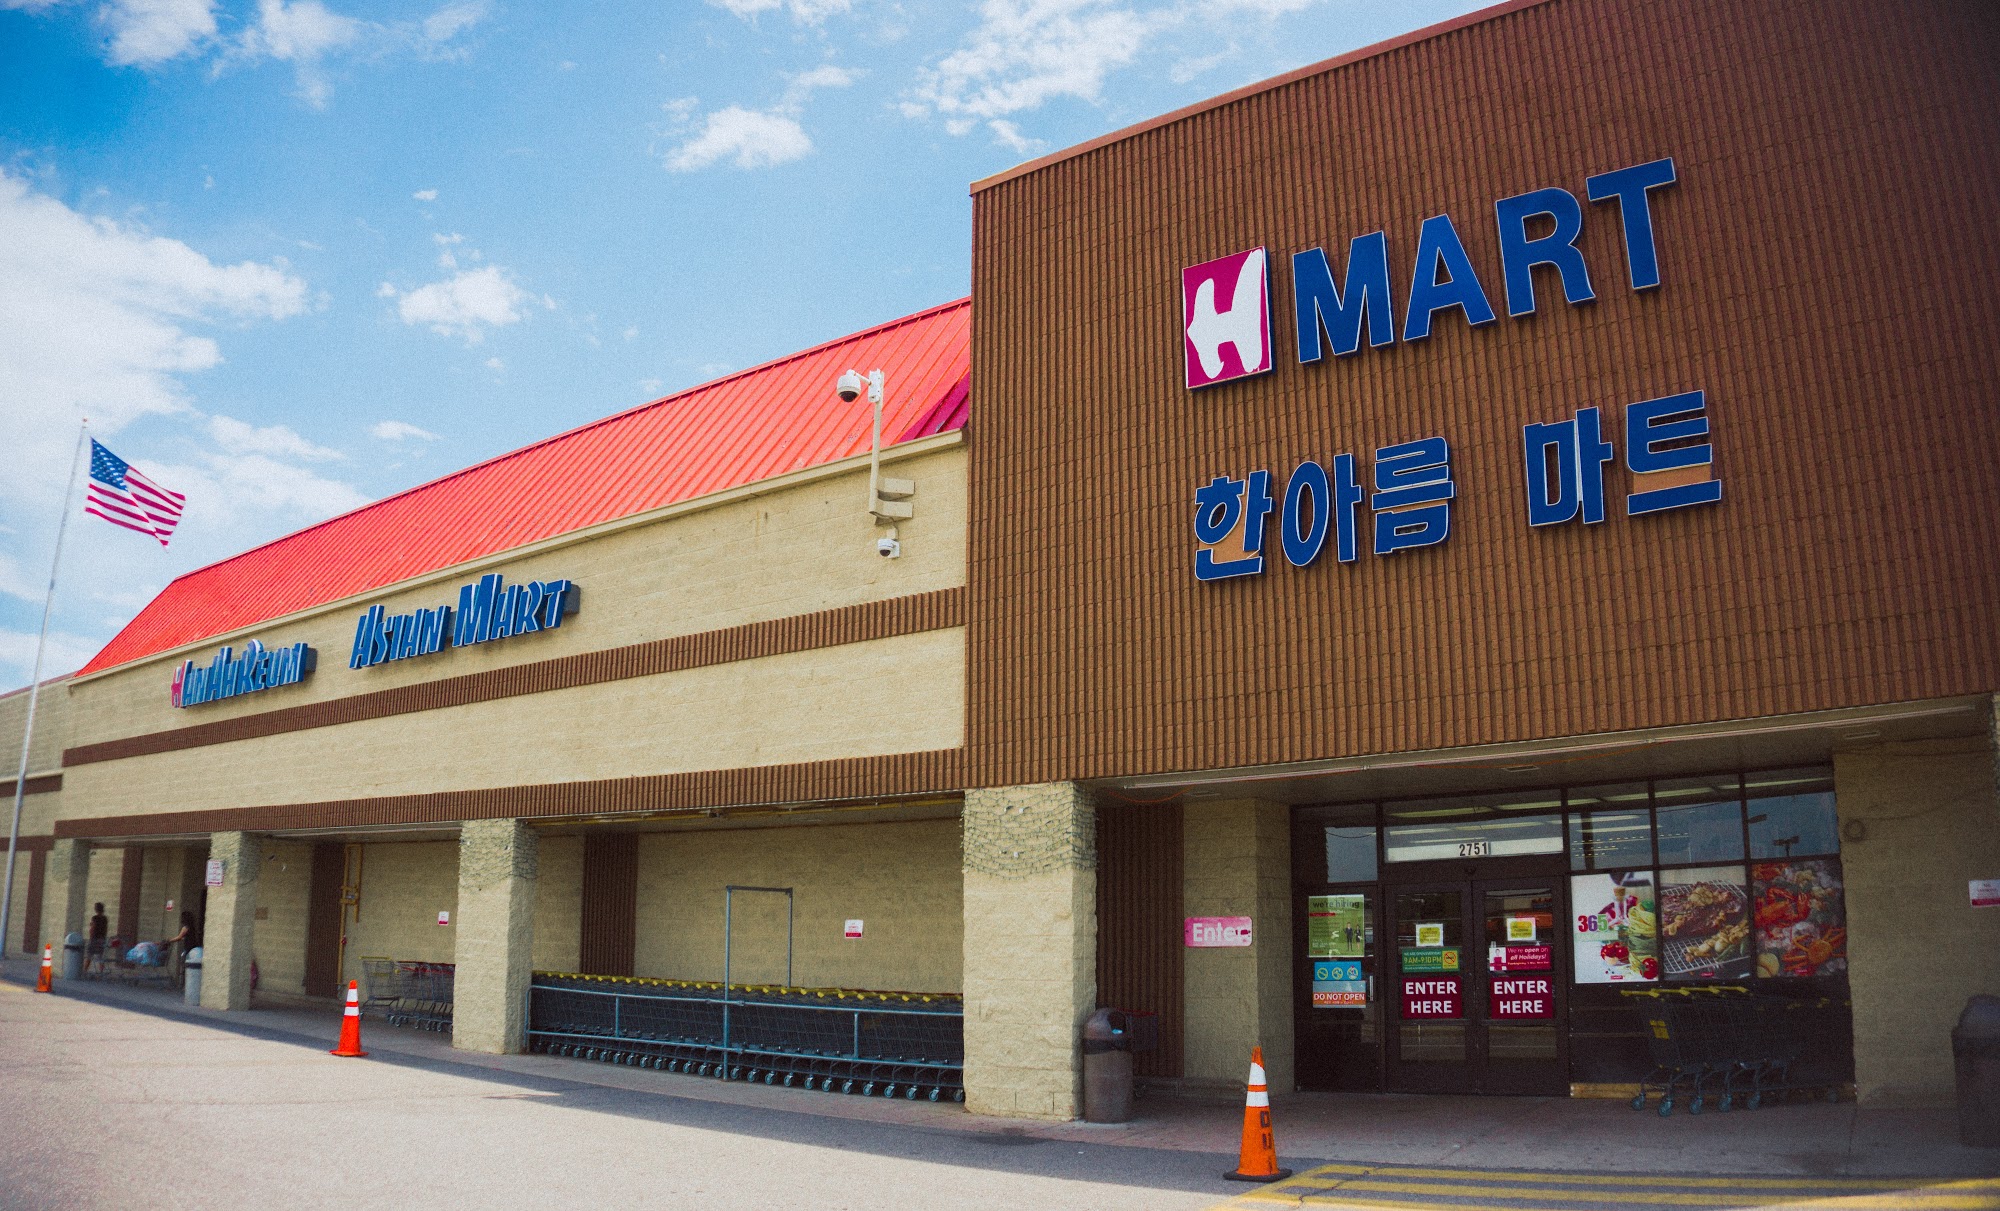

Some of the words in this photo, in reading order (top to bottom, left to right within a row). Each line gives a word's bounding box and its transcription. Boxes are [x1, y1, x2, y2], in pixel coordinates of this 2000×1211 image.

[1186, 248, 1265, 379] H
[1292, 157, 1677, 364] MART
[1194, 436, 1458, 581] 한아름
[1523, 390, 1722, 528] 마트
[349, 604, 451, 669] ASIAN
[452, 573, 571, 648] MART
[1458, 841, 1488, 857] 2751
[1335, 899, 1360, 909] hiring
[1577, 914, 1609, 932] 365
[1192, 922, 1248, 942] Enter
[1405, 981, 1457, 995] ENTER
[1493, 980, 1549, 995] ENTER
[1313, 993, 1326, 1001] DO
[1326, 993, 1343, 1001] NOT
[1343, 993, 1365, 1001] OPEN
[1410, 1000, 1453, 1014] HERE
[1499, 999, 1544, 1014] HERE
